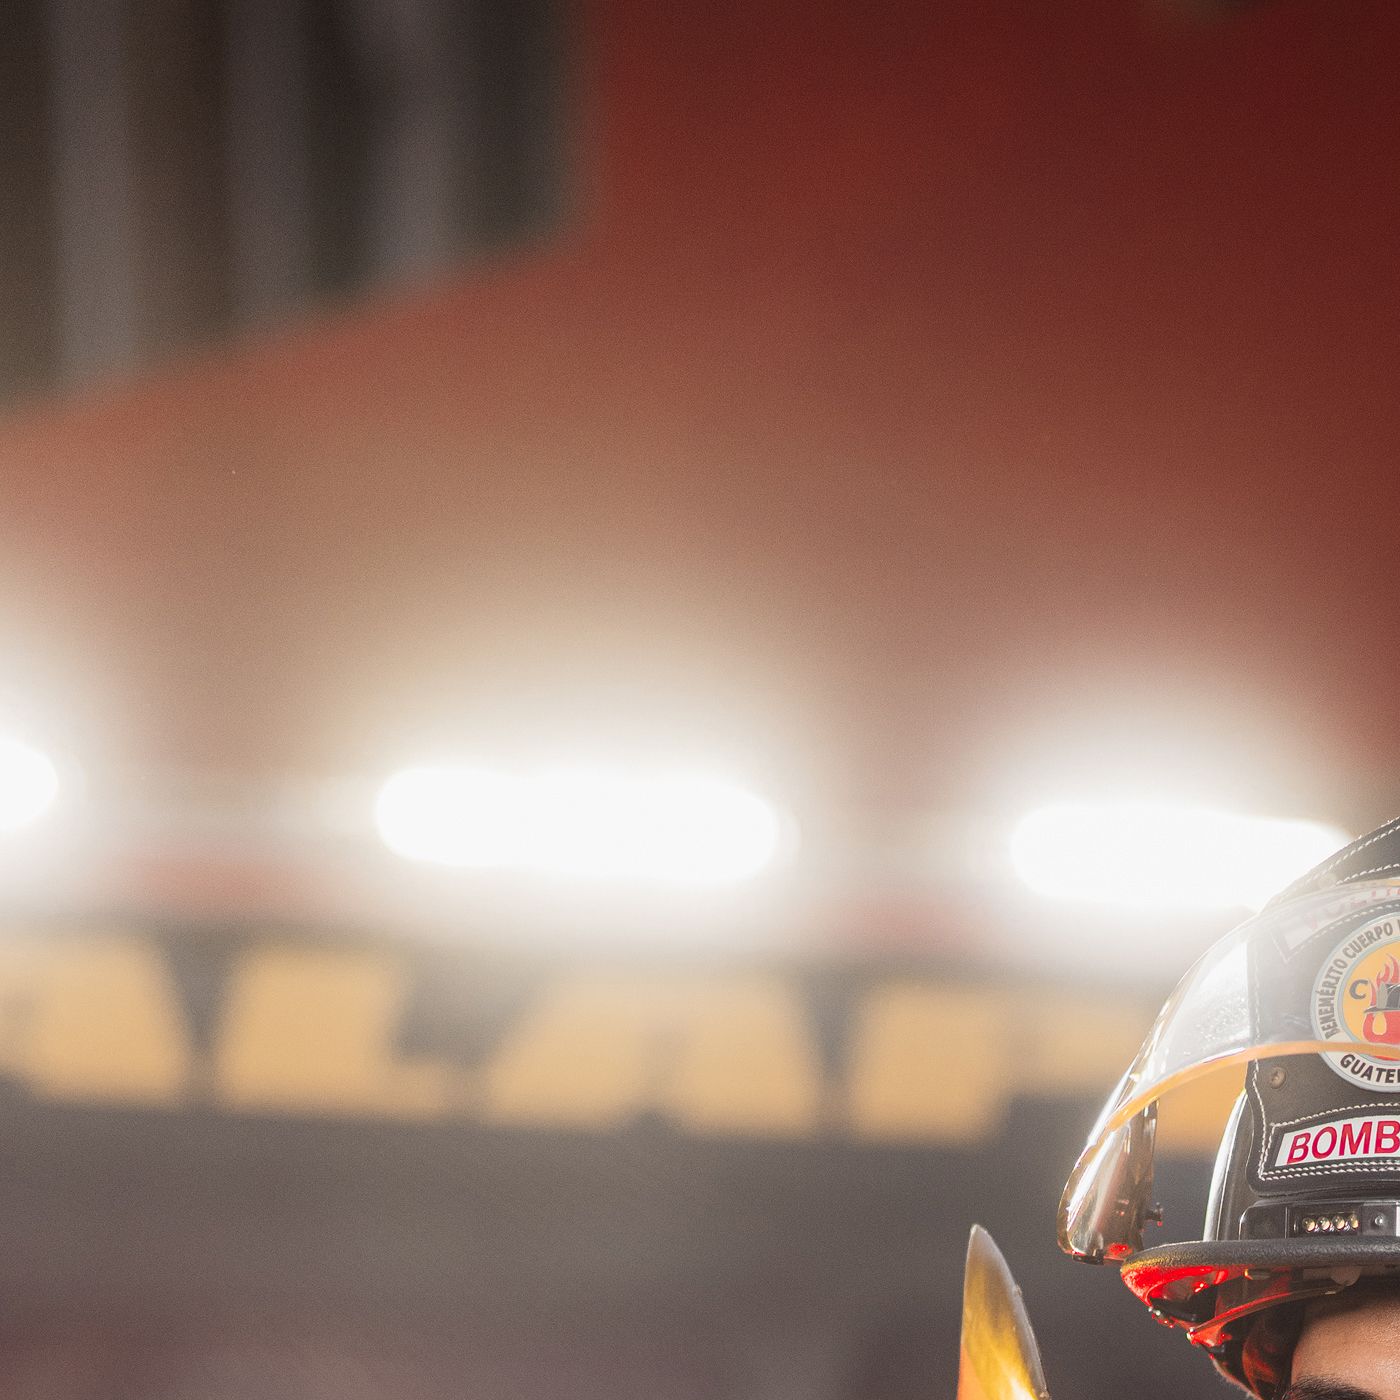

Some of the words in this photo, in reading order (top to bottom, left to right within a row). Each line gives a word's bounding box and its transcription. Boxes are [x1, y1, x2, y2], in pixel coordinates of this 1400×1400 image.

[1317, 958, 1348, 1039] BENEMÉRITO
[1342, 923, 1394, 959] CUERPO
[1350, 979, 1369, 1000] C
